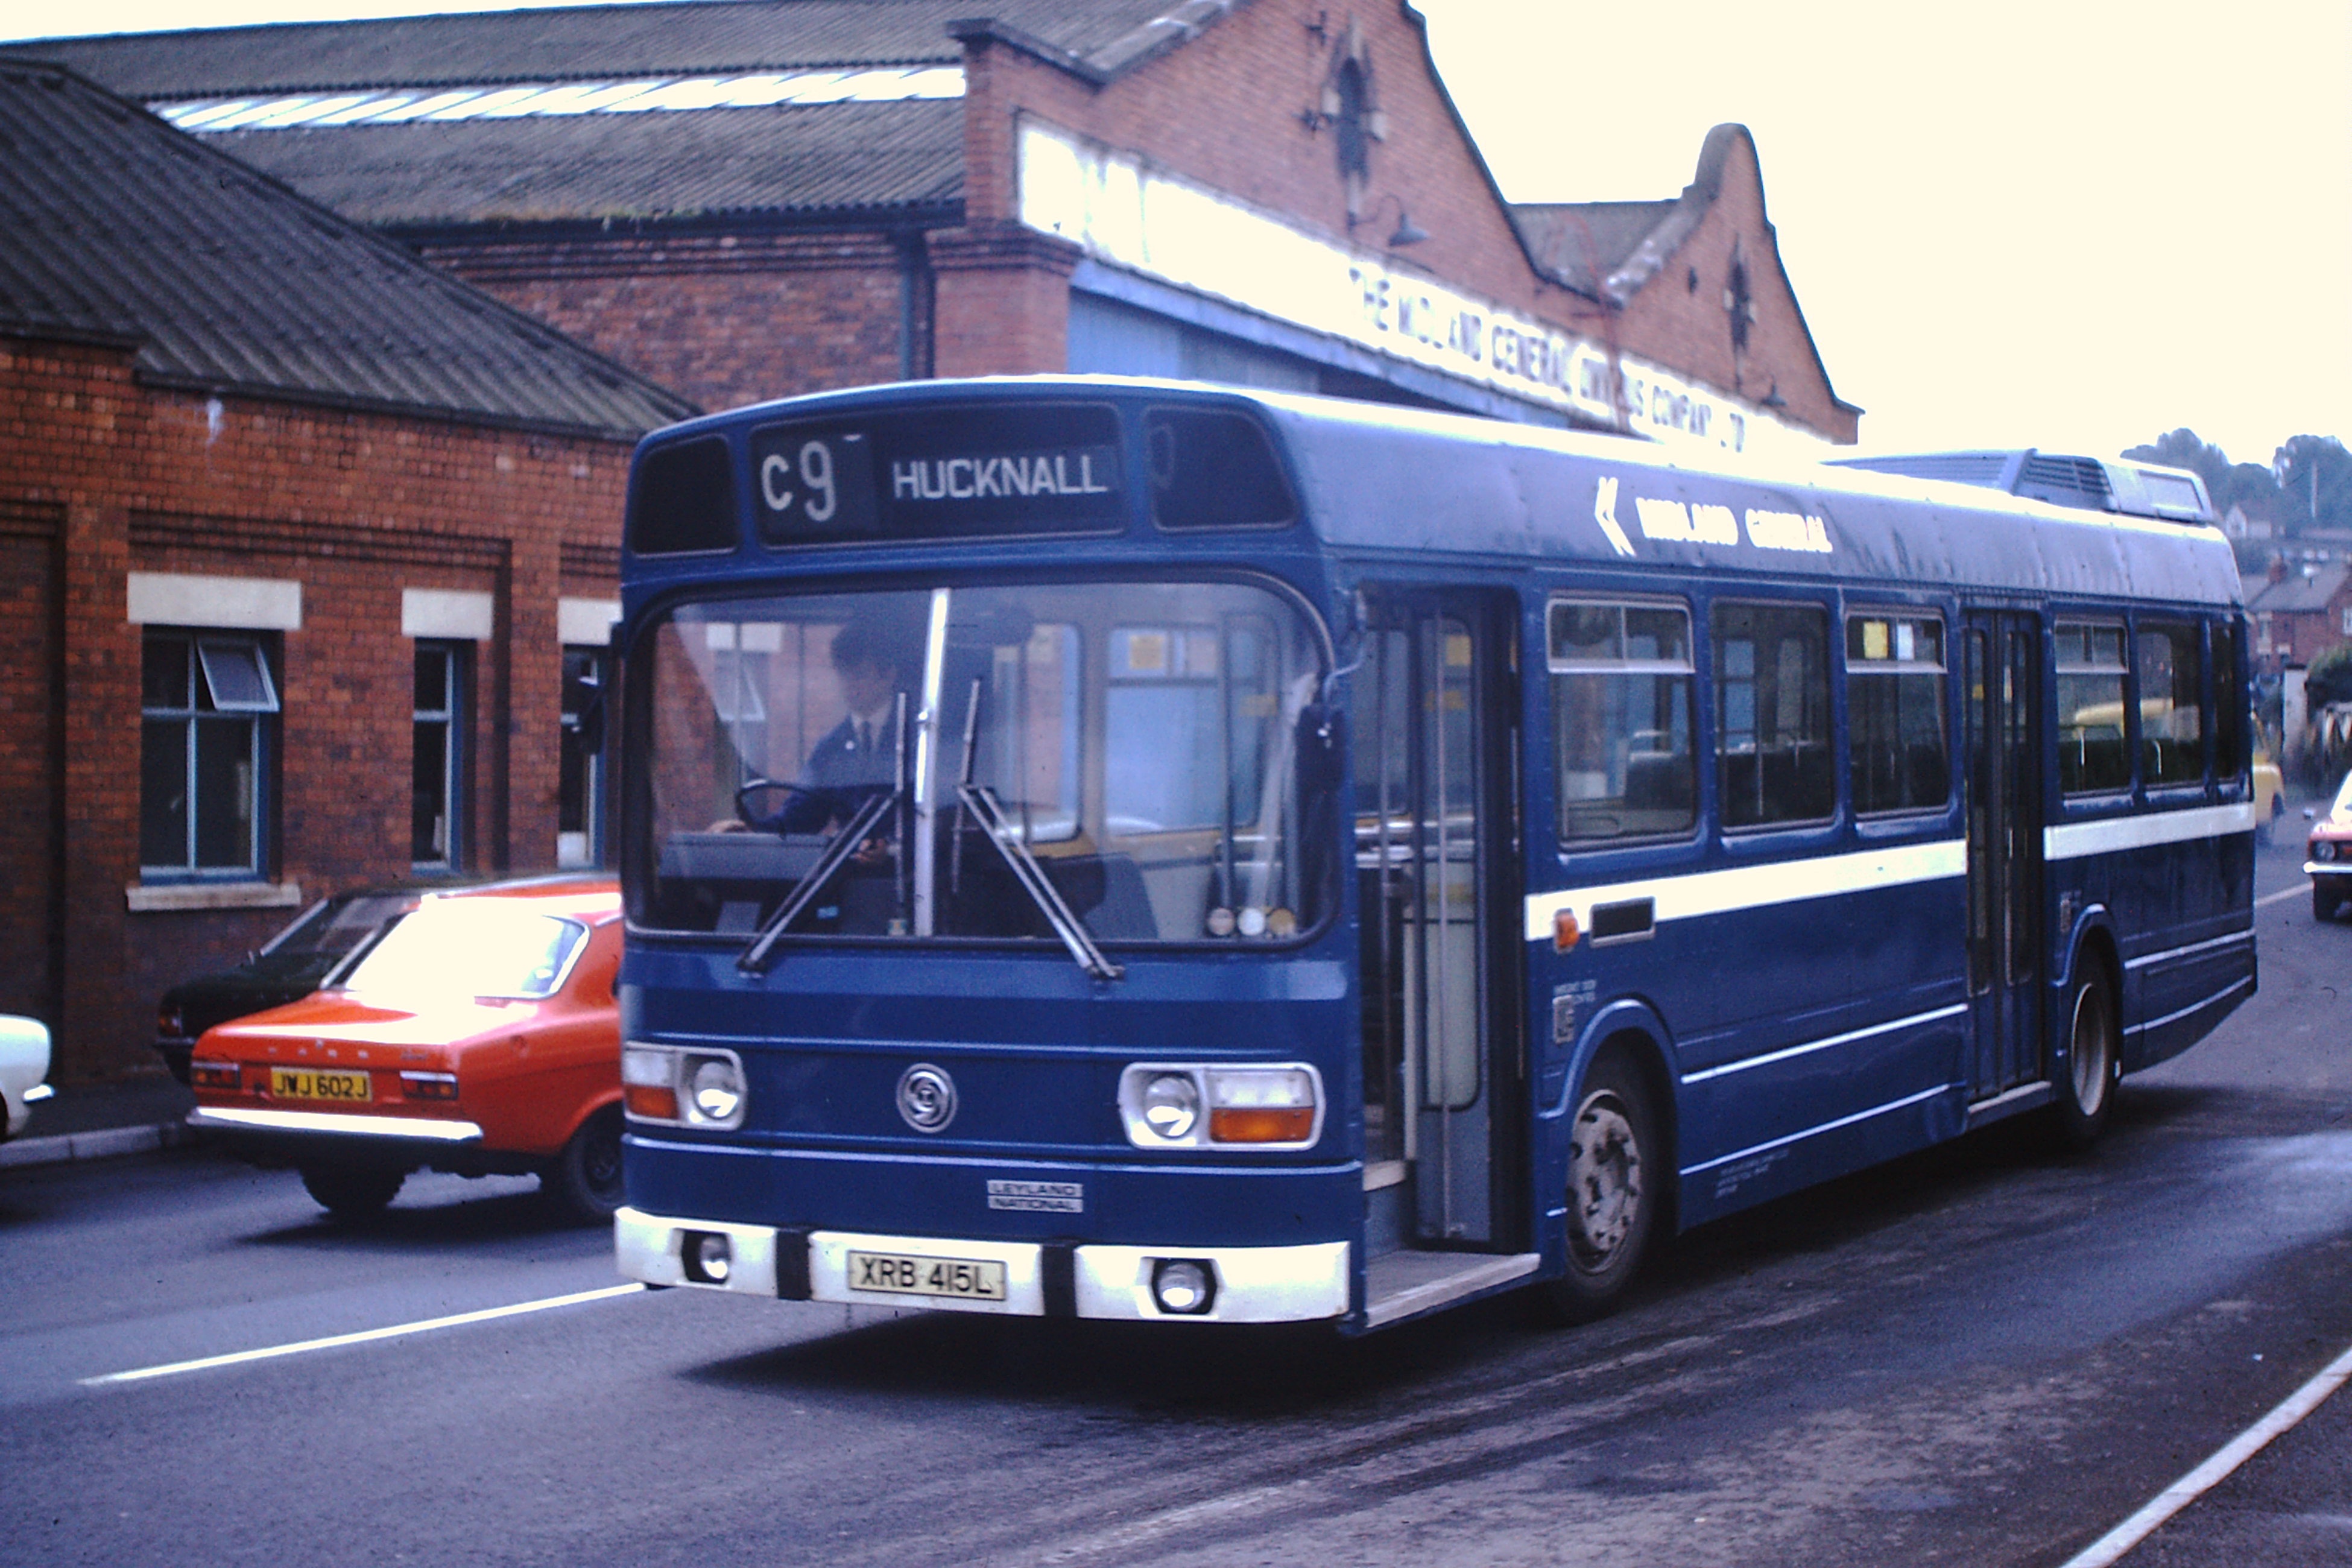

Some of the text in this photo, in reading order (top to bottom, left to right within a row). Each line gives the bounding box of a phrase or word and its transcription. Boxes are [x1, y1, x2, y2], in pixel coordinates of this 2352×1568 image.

[893, 454, 1108, 499] HUCKNALL
[317, 1075, 368, 1098] 602J
[993, 1183, 1075, 1196] LEYLAND
[994, 1198, 1074, 1211] NATIONAL
[860, 1257, 993, 1295] XRB 415L
